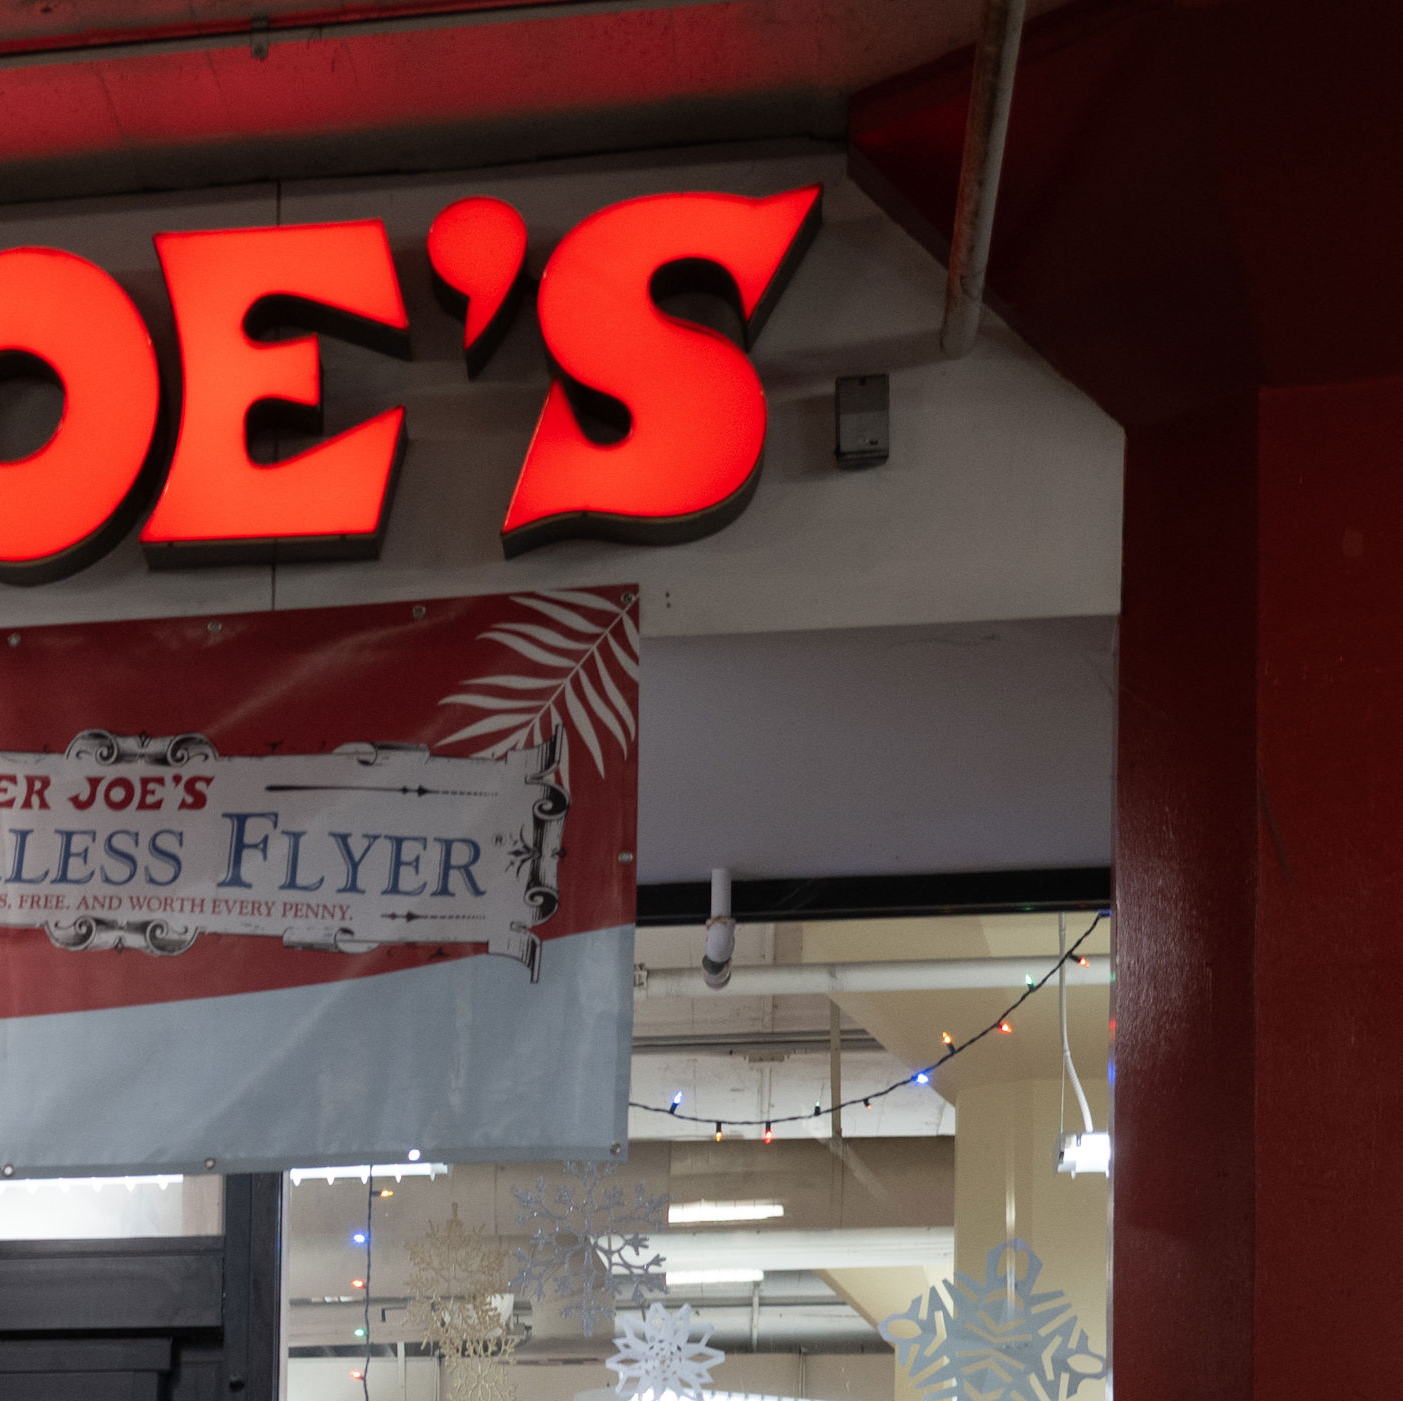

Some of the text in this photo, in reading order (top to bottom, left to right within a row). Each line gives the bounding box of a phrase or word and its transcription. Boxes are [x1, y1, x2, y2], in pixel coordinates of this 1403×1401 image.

[67, 775, 215, 812] JOE'S
[217, 812, 486, 897] FLYER
[18, 893, 70, 911] FREE.
[76, 895, 122, 912] AND
[126, 896, 210, 915] WORTH
[211, 898, 277, 917] EVERY
[282, 901, 354, 921] PENNY.
